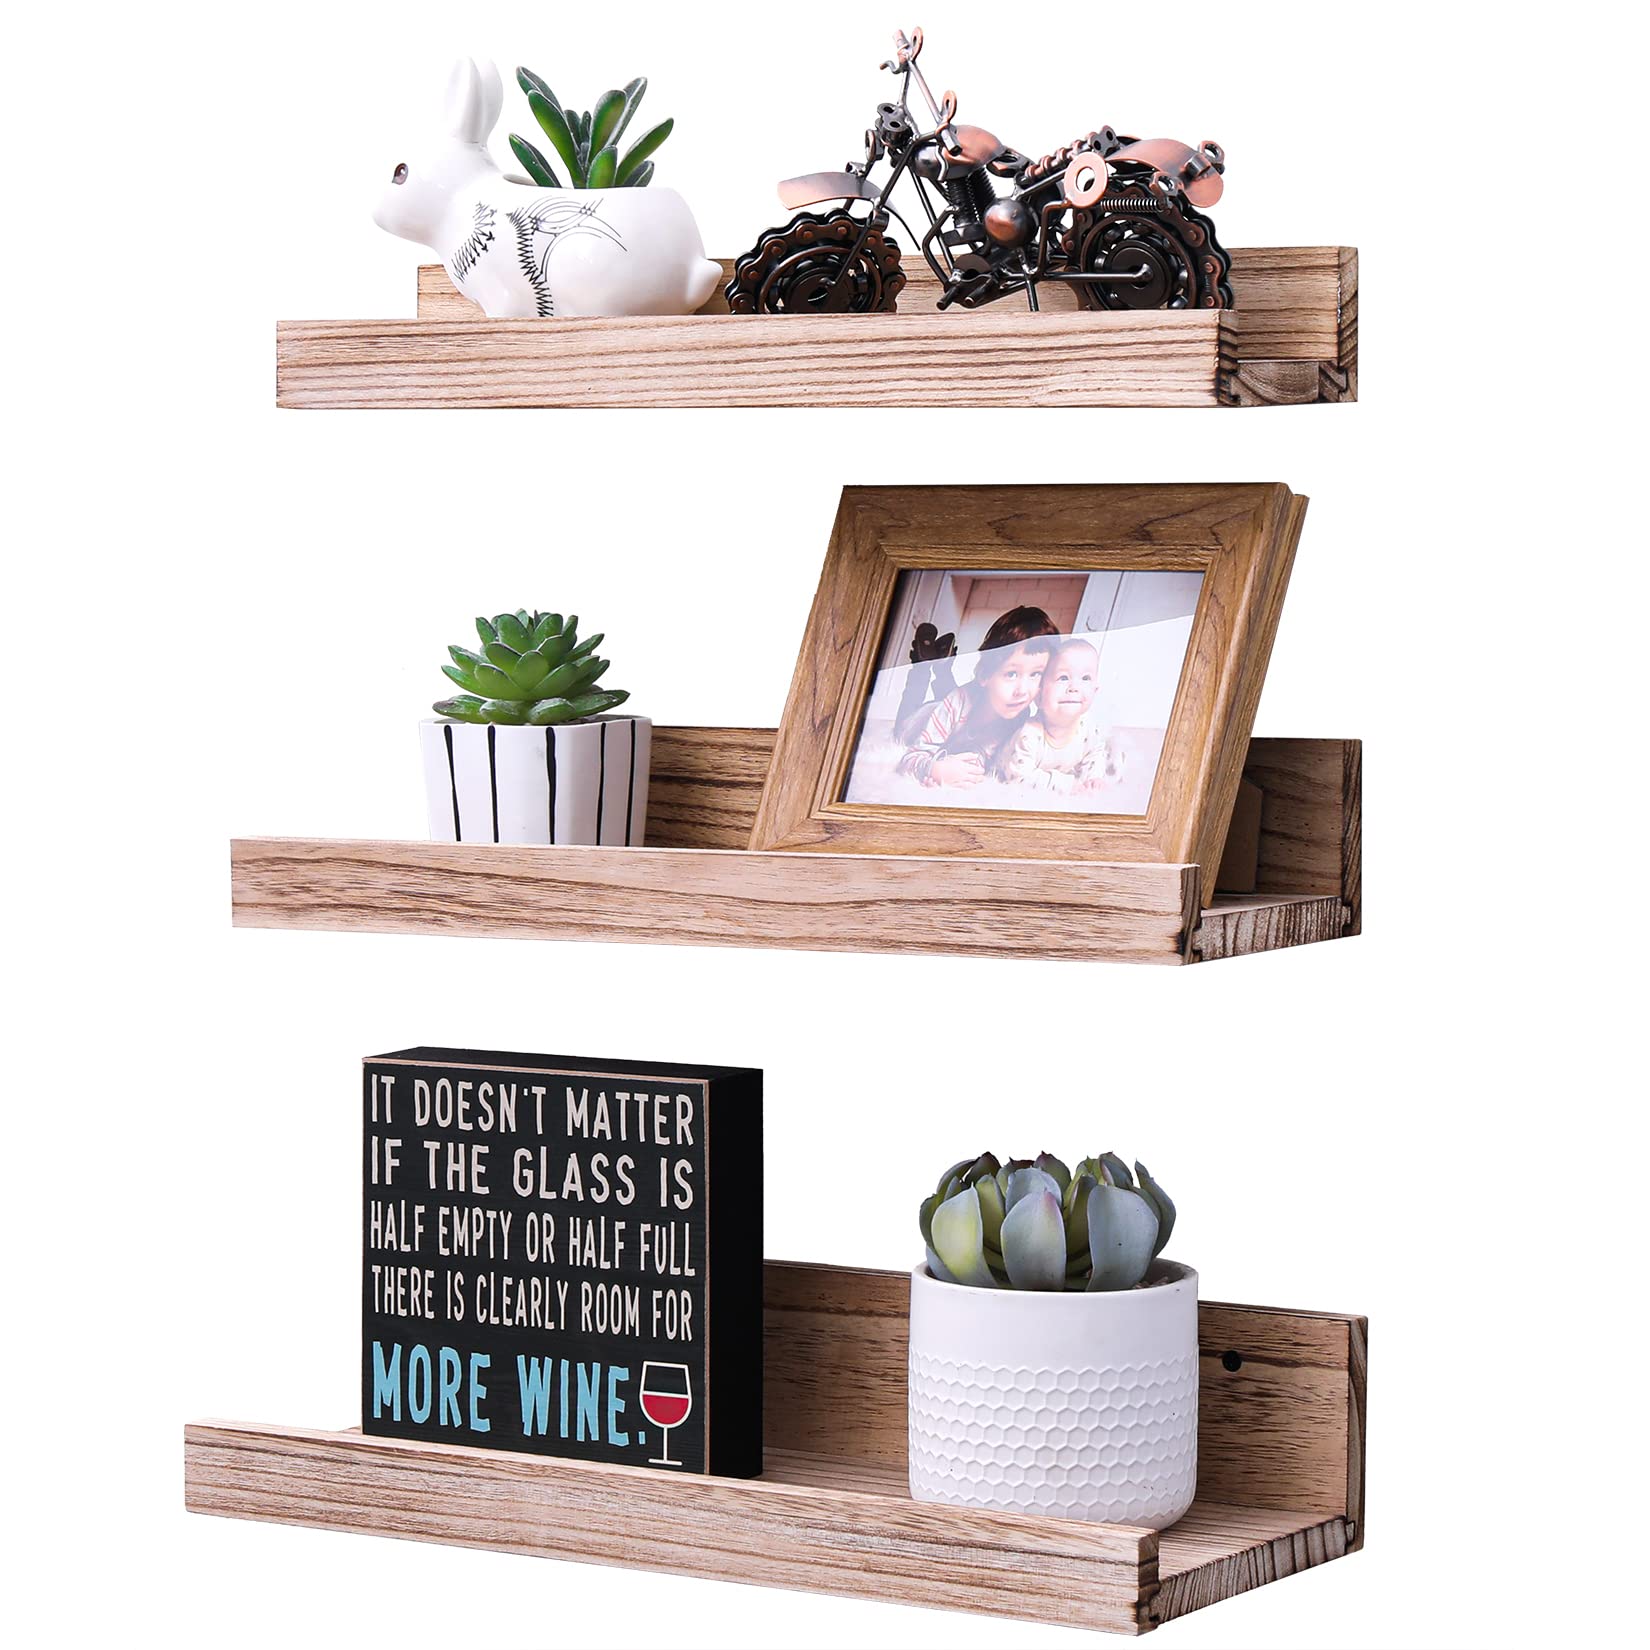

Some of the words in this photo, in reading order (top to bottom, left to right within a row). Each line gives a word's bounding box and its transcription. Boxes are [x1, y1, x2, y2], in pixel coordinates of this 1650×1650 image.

[371, 1073, 396, 1124] IT
[414, 1077, 547, 1135] DOESN'T
[566, 1086, 695, 1146] MATTER
[371, 1135, 403, 1186] IF
[423, 1140, 490, 1195] THE
[512, 1146, 636, 1206] GLASS
[660, 1157, 694, 1210] IS
[370, 1199, 426, 1253] HALF
[438, 1206, 513, 1260] EMPTY
[525, 1211, 555, 1264] OR
[568, 1215, 626, 1270] HALF
[639, 1221, 696, 1277] FULL
[371, 1264, 435, 1320] THERE
[446, 1270, 465, 1322] IS
[476, 1271, 569, 1331] CLEARLY
[581, 1281, 640, 1337] ROOM
[652, 1288, 693, 1342] FOR
[372, 1340, 491, 1433] MORE
[516, 1354, 646, 1447] WINE.
